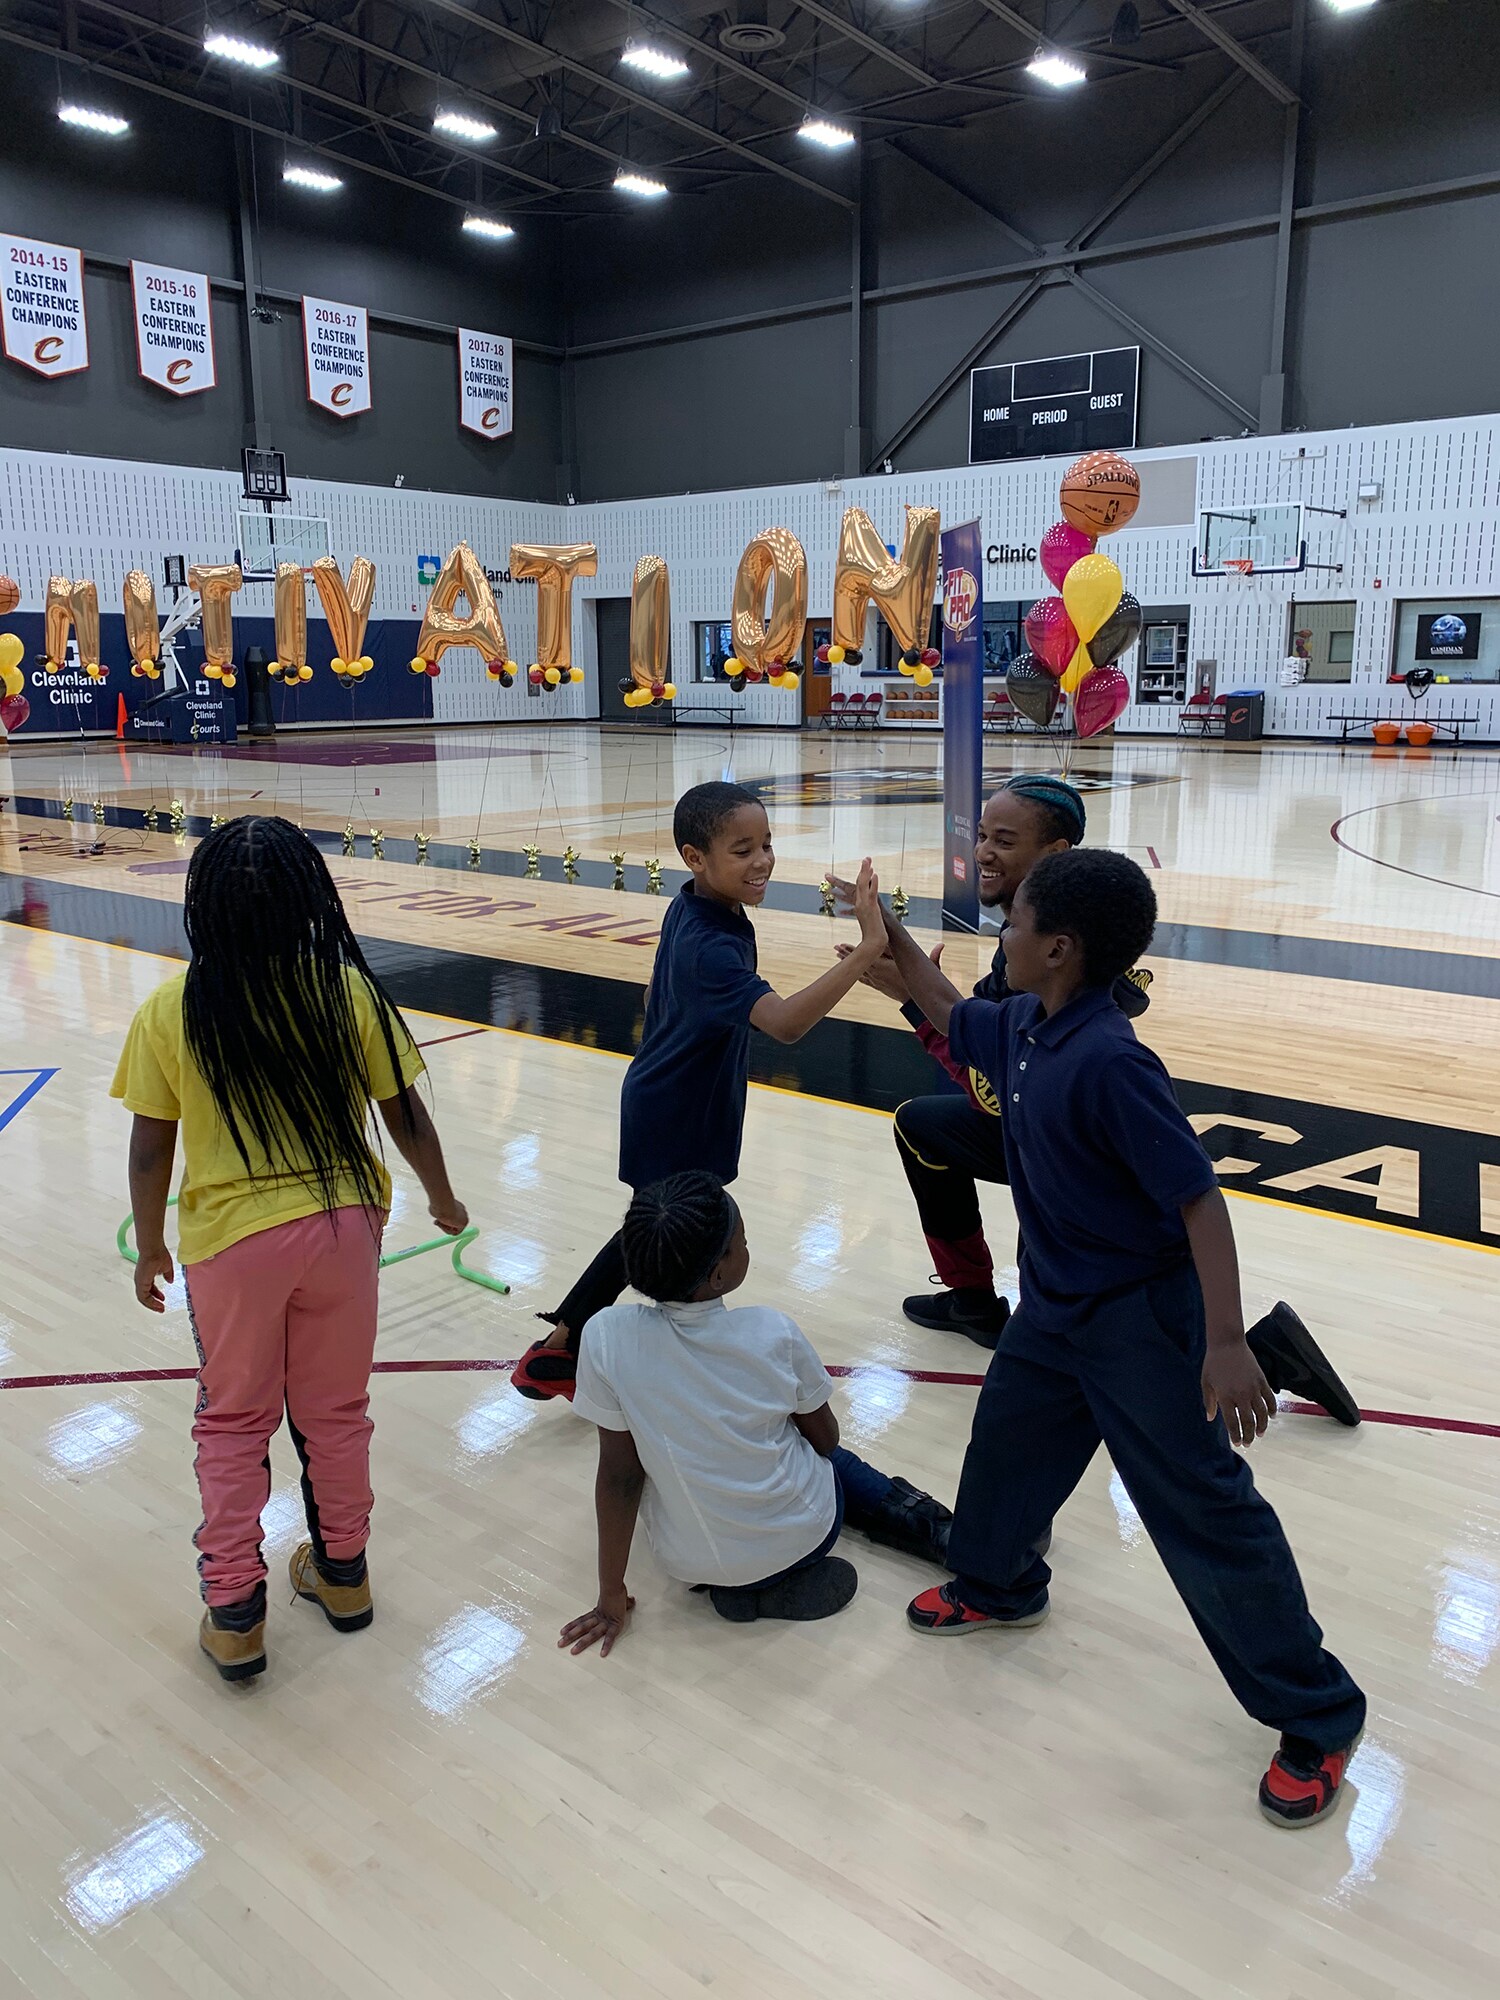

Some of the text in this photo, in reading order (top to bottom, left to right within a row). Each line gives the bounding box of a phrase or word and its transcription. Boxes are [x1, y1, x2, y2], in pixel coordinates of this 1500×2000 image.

[10, 248, 68, 272] 2014-15
[15, 271, 67, 293] EASTERN
[146, 276, 196, 298] 2015-16
[7, 288, 79, 313] CONFERENCE
[150, 298, 195, 318] EASTERN
[12, 307, 77, 331] CHAMPIONS
[142, 314, 206, 337] CONFERENCE
[315, 308, 357, 327] 2016-17
[147, 332, 205, 354] CHAMPIONS
[318, 327, 356, 345] EASTERN
[311, 343, 365, 362] CONFERENCE
[468, 339, 504, 356] 2017-18
[315, 359, 363, 378] CHAMPIONS
[470, 357, 503, 372] EASTERN
[464, 371, 509, 389] CONFERENCE
[466, 386, 508, 402] CHAMPIONS
[1090, 393, 1123, 410] GUEST
[983, 407, 1010, 422] HOME
[1032, 409, 1067, 425] PERIOD
[987, 543, 1037, 564] Clinic
[31, 671, 107, 687] Cleveland
[49, 690, 93, 704] Clinic
[186, 701, 223, 710] Cleveland
[194, 711, 216, 719] Clinic
[355, 889, 661, 947] FOR ALL
